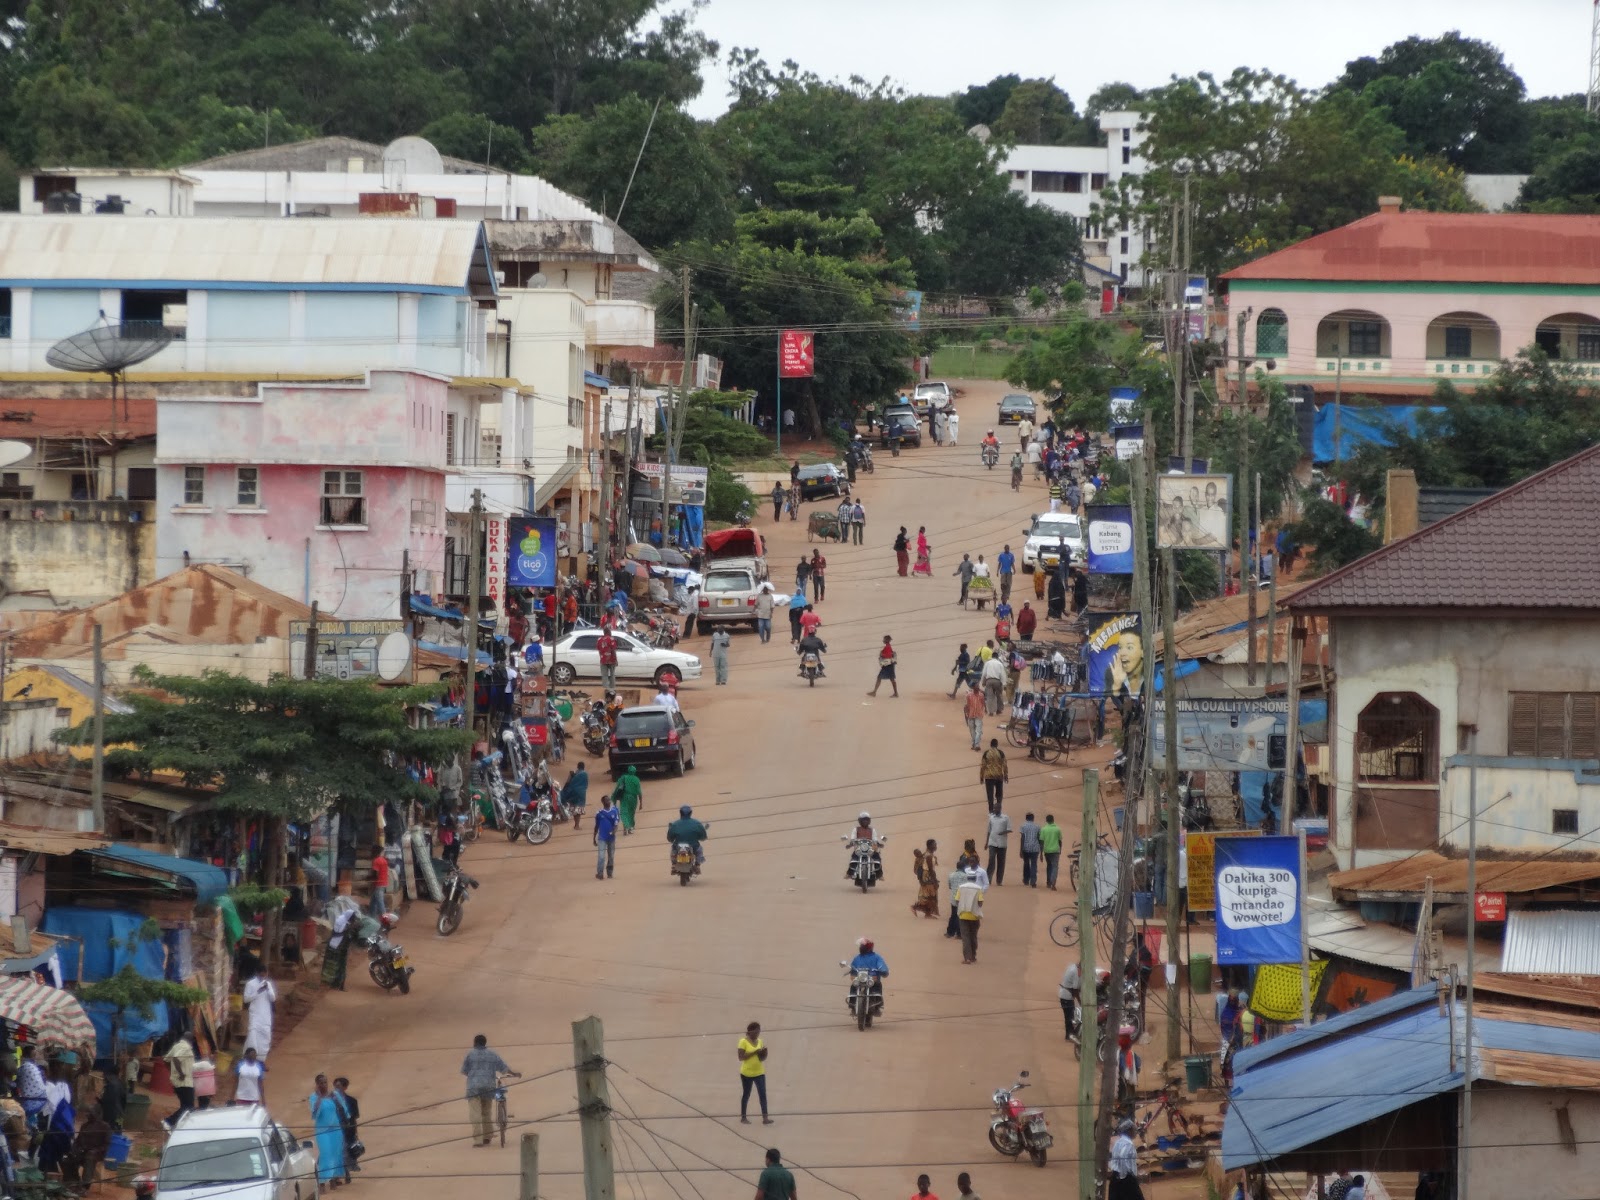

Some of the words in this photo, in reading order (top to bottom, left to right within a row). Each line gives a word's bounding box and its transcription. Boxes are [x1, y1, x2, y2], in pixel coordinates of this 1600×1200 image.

[489, 520, 499, 553] DUKA
[489, 556, 499, 573] LA
[523, 559, 542, 572] tigo
[1089, 614, 1138, 654] KABAANG!
[1201, 700, 1250, 713] QUALITY
[1224, 872, 1265, 884] Dakika
[1269, 873, 1290, 883] 300
[1237, 885, 1278, 898] kupiga
[1231, 899, 1285, 911] mtandao
[1488, 897, 1502, 905] airtel
[1233, 912, 1283, 923] wowote!
